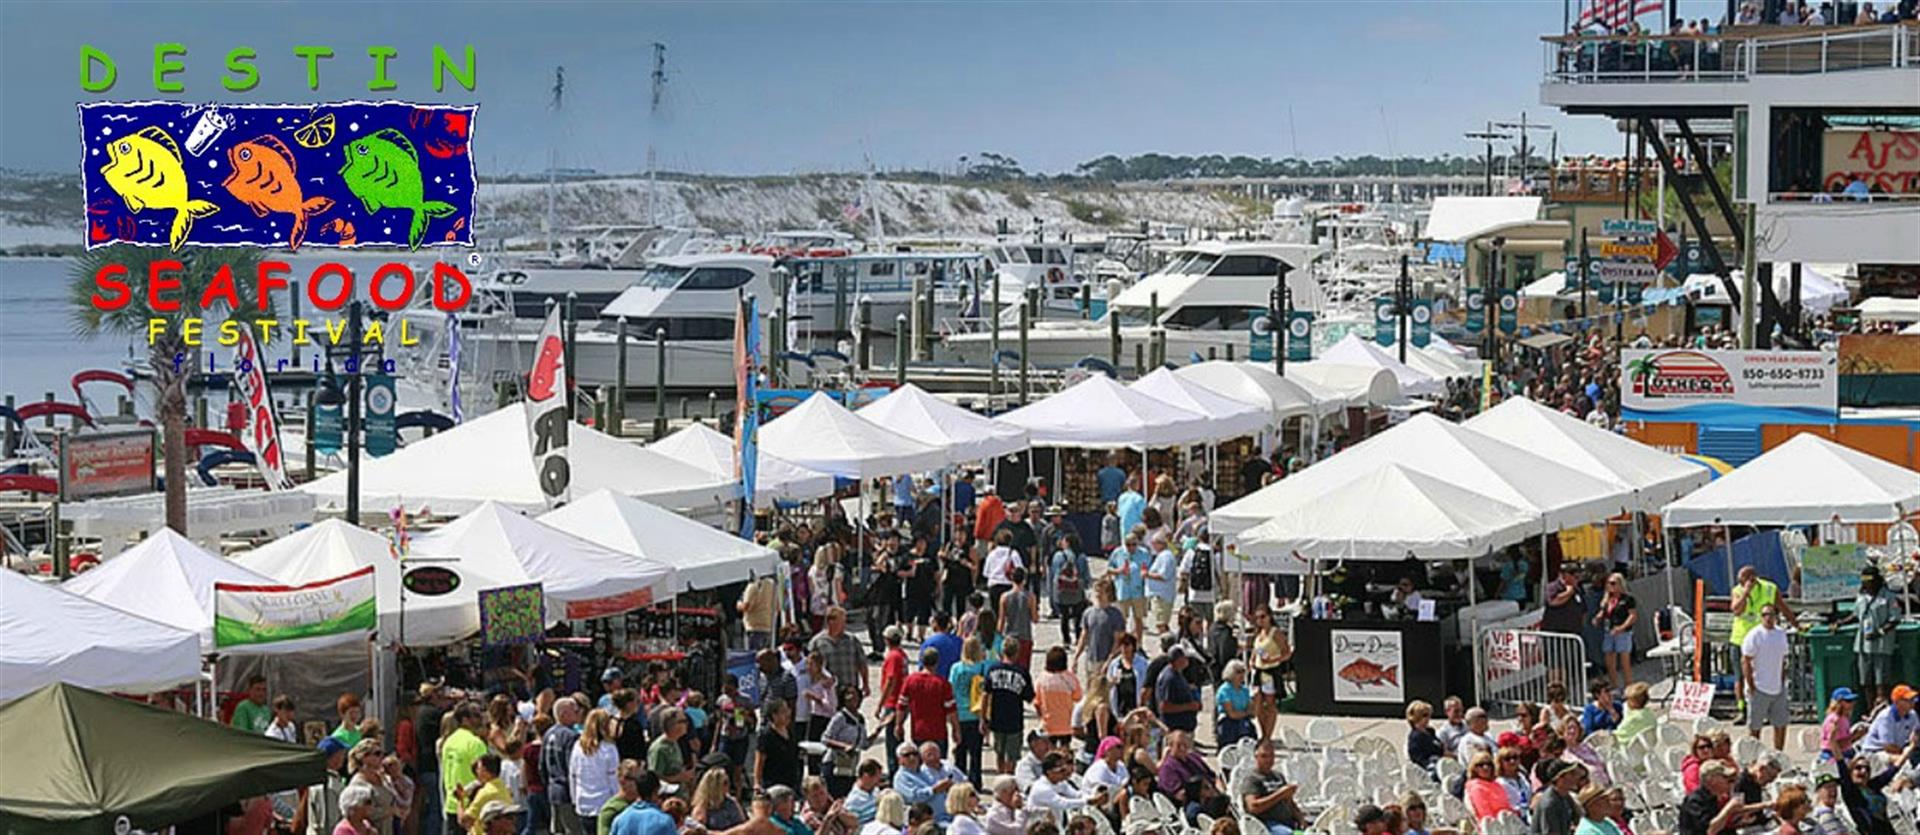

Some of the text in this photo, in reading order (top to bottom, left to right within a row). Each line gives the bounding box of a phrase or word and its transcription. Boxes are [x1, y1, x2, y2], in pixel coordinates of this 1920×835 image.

[1491, 631, 1514, 646] VIP
[1488, 646, 1519, 663] AREA
[1683, 682, 1710, 698] VIP
[1673, 697, 1708, 714] AREA
